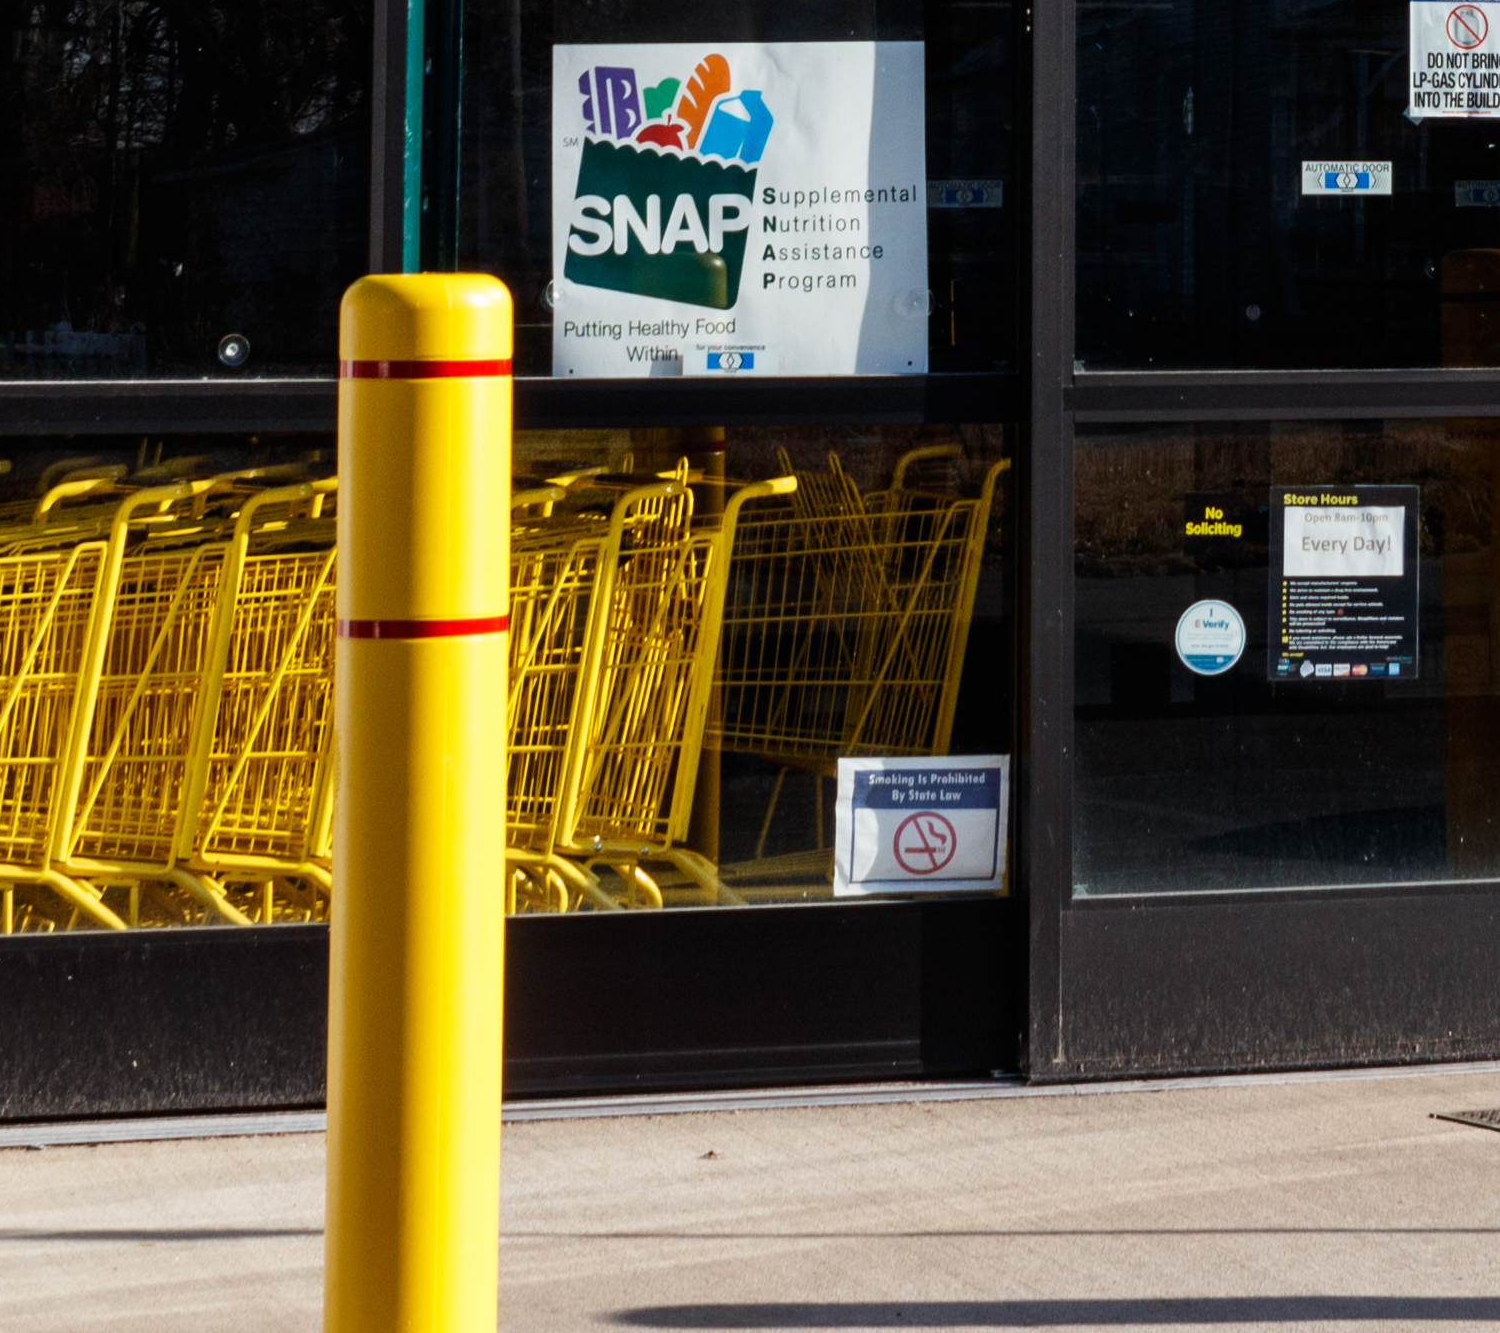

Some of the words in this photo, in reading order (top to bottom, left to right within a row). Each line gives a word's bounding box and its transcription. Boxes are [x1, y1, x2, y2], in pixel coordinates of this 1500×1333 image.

[1427, 53, 1444, 69] DO
[1446, 53, 1469, 69] NOT
[1413, 72, 1455, 89] LP-GAS
[1414, 92, 1440, 109] INTO
[1443, 92, 1464, 109] THE
[1305, 163, 1359, 172] AUTOMATIC
[1362, 163, 1389, 172] DOOR
[762, 185, 917, 209] Supplemental
[567, 193, 752, 255] SNAP
[762, 215, 861, 233] Nutrition
[762, 243, 884, 262] Assistance
[762, 271, 857, 293] Program
[564, 321, 622, 340] Putting
[628, 319, 690, 339] Healthy
[695, 318, 736, 334] Food
[626, 345, 679, 362] Within
[1283, 493, 1318, 505] Store
[1320, 493, 1358, 505] Hours
[1205, 507, 1224, 520] No
[1304, 512, 1331, 523] Open
[1335, 511, 1388, 523] 8am-10pm
[1185, 521, 1242, 537] Soliciting
[1301, 536, 1348, 555] Every
[1353, 535, 1392, 555] Day!
[868, 774, 914, 786] Smoking
[918, 774, 927, 784] Is
[930, 772, 986, 784] Prohibited
[891, 789, 904, 803] By
[908, 789, 937, 801] State
[939, 789, 962, 801] Law
